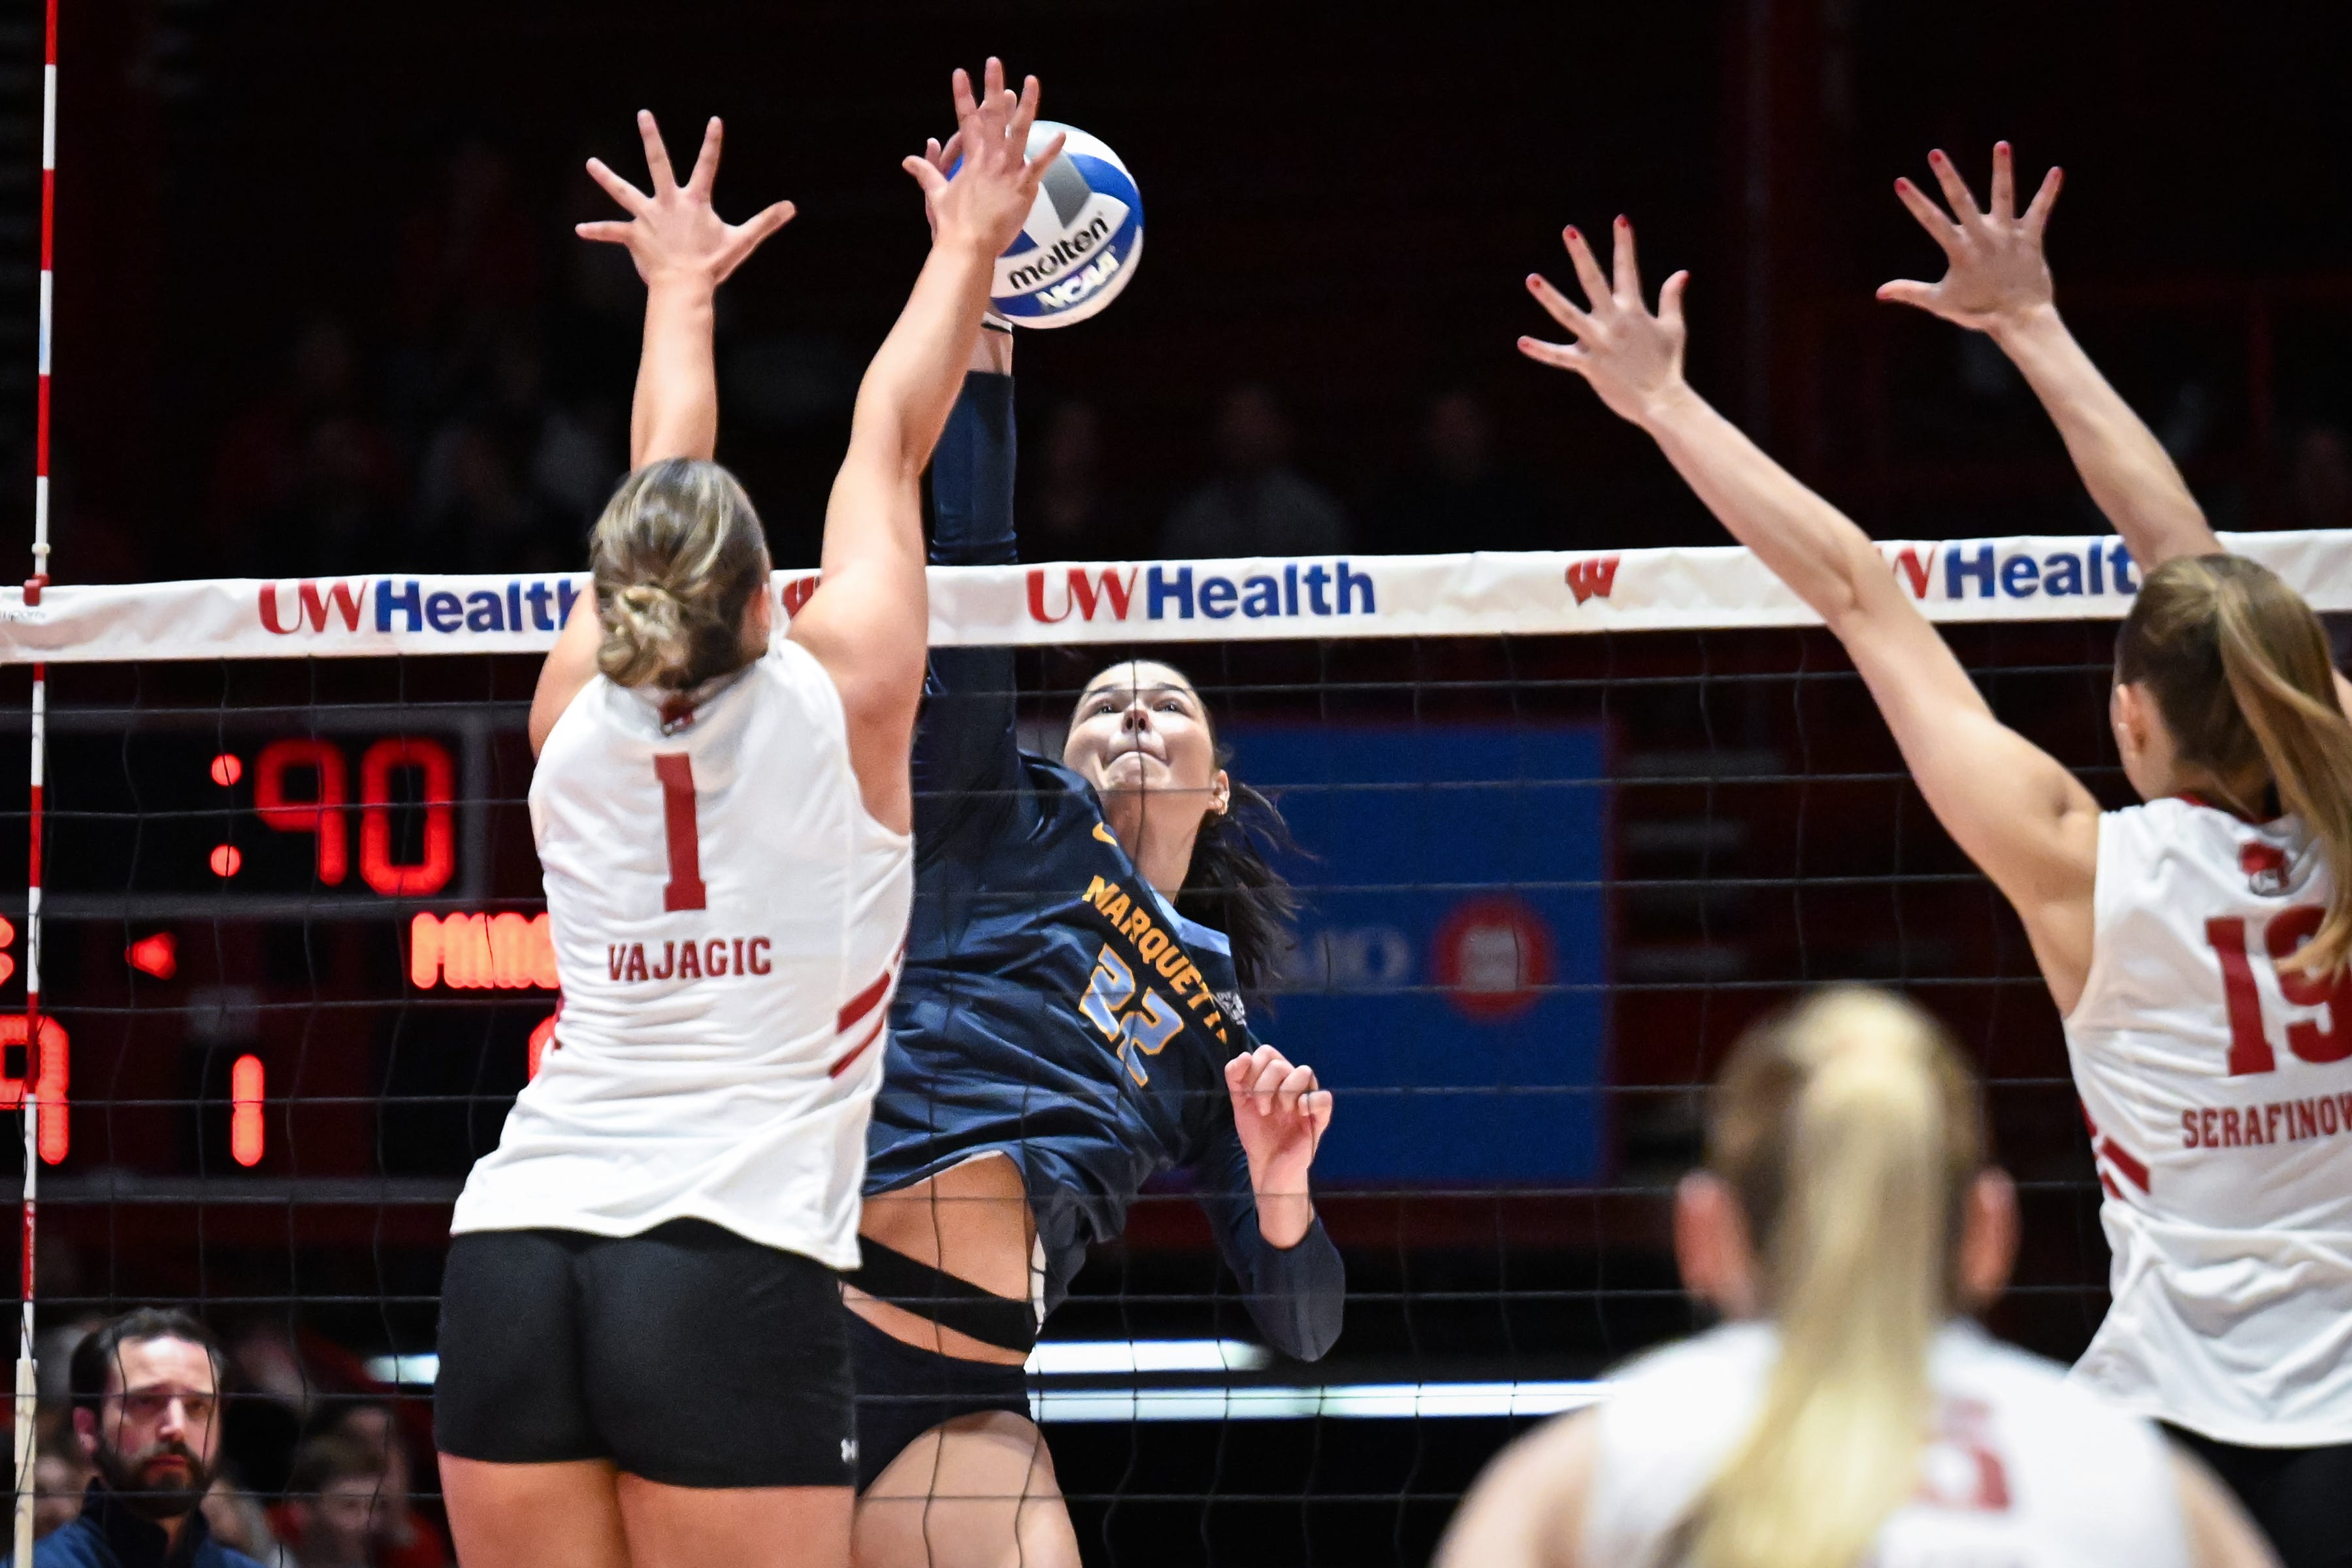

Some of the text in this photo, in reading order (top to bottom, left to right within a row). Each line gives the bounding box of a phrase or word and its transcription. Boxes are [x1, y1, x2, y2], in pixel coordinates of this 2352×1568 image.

[1008, 218, 1108, 290] molten
[1026, 563, 1376, 623] UW Health
[1945, 537, 2138, 599] Healt
[259, 579, 368, 634] UW
[654, 753, 706, 911] 1
[608, 937, 771, 981] VAJAGIC
[1079, 943, 1184, 1086] 22
